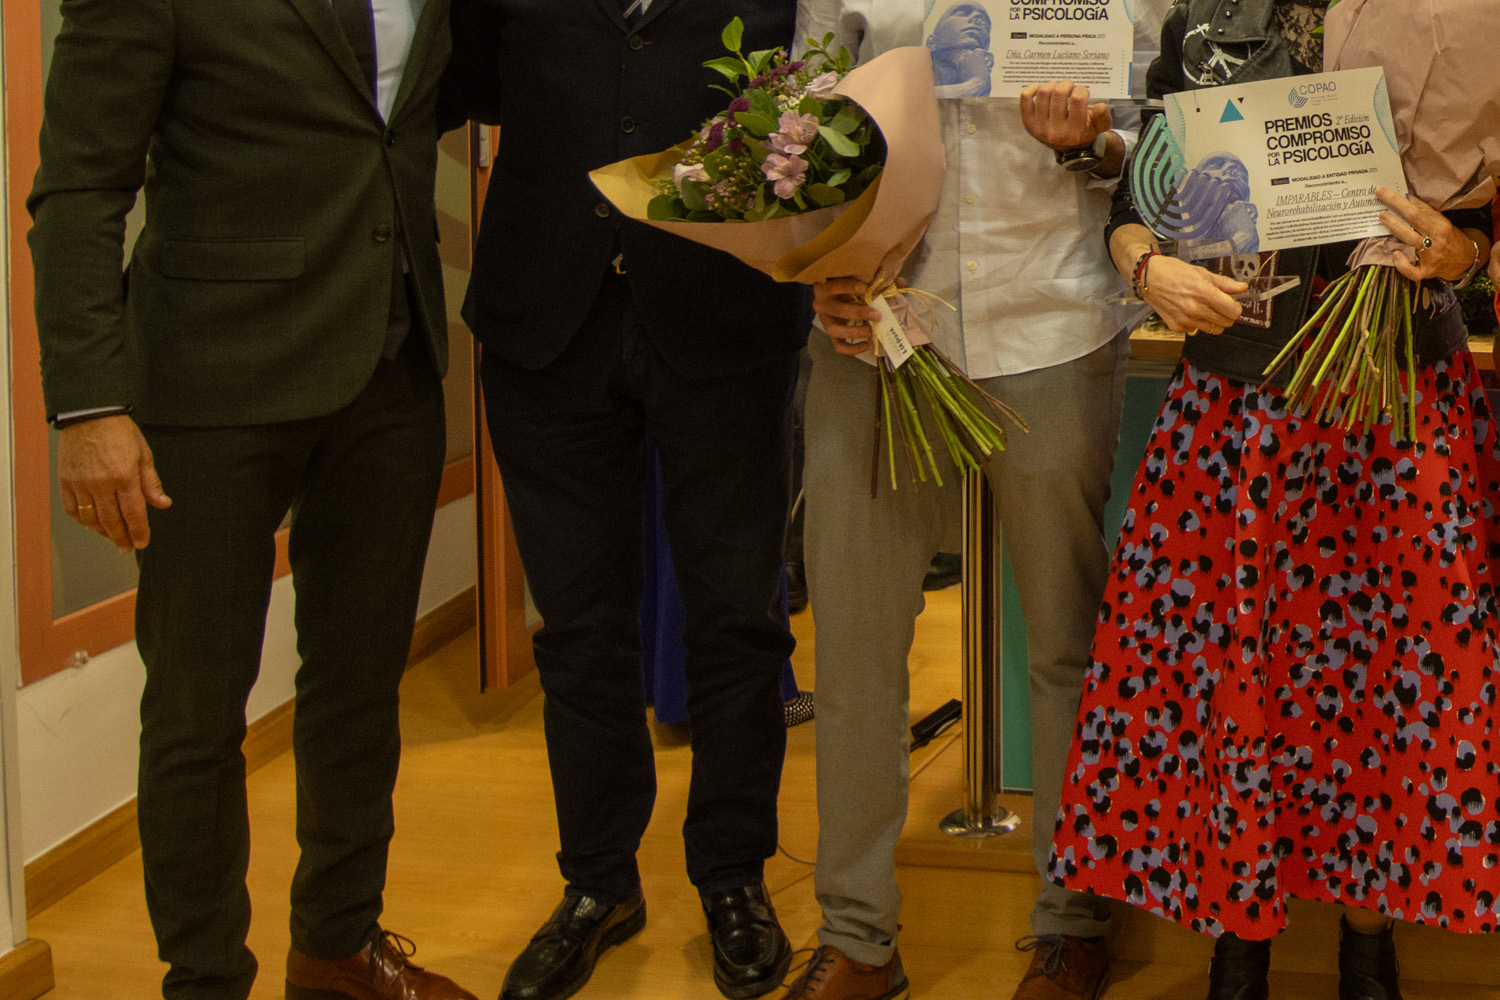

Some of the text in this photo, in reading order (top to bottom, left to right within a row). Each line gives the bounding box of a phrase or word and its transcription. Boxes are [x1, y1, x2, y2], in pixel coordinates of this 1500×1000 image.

[1023, 50, 1051, 59] Carmen
[1052, 50, 1082, 59] Luciano
[1082, 50, 1110, 60] Soriano
[1299, 81, 1337, 95] COPAO
[1265, 112, 1333, 134] PREMIOS
[1344, 113, 1370, 125] Edición
[1267, 125, 1371, 150] COMPROMISO
[1268, 158, 1281, 166] LA
[1292, 174, 1322, 182] MODALIDAD
[1276, 190, 1333, 206] IMPARABLES
[1341, 187, 1367, 198] Centro
[1367, 185, 1378, 195] de
[1266, 200, 1341, 218] Neurorehabilitación
